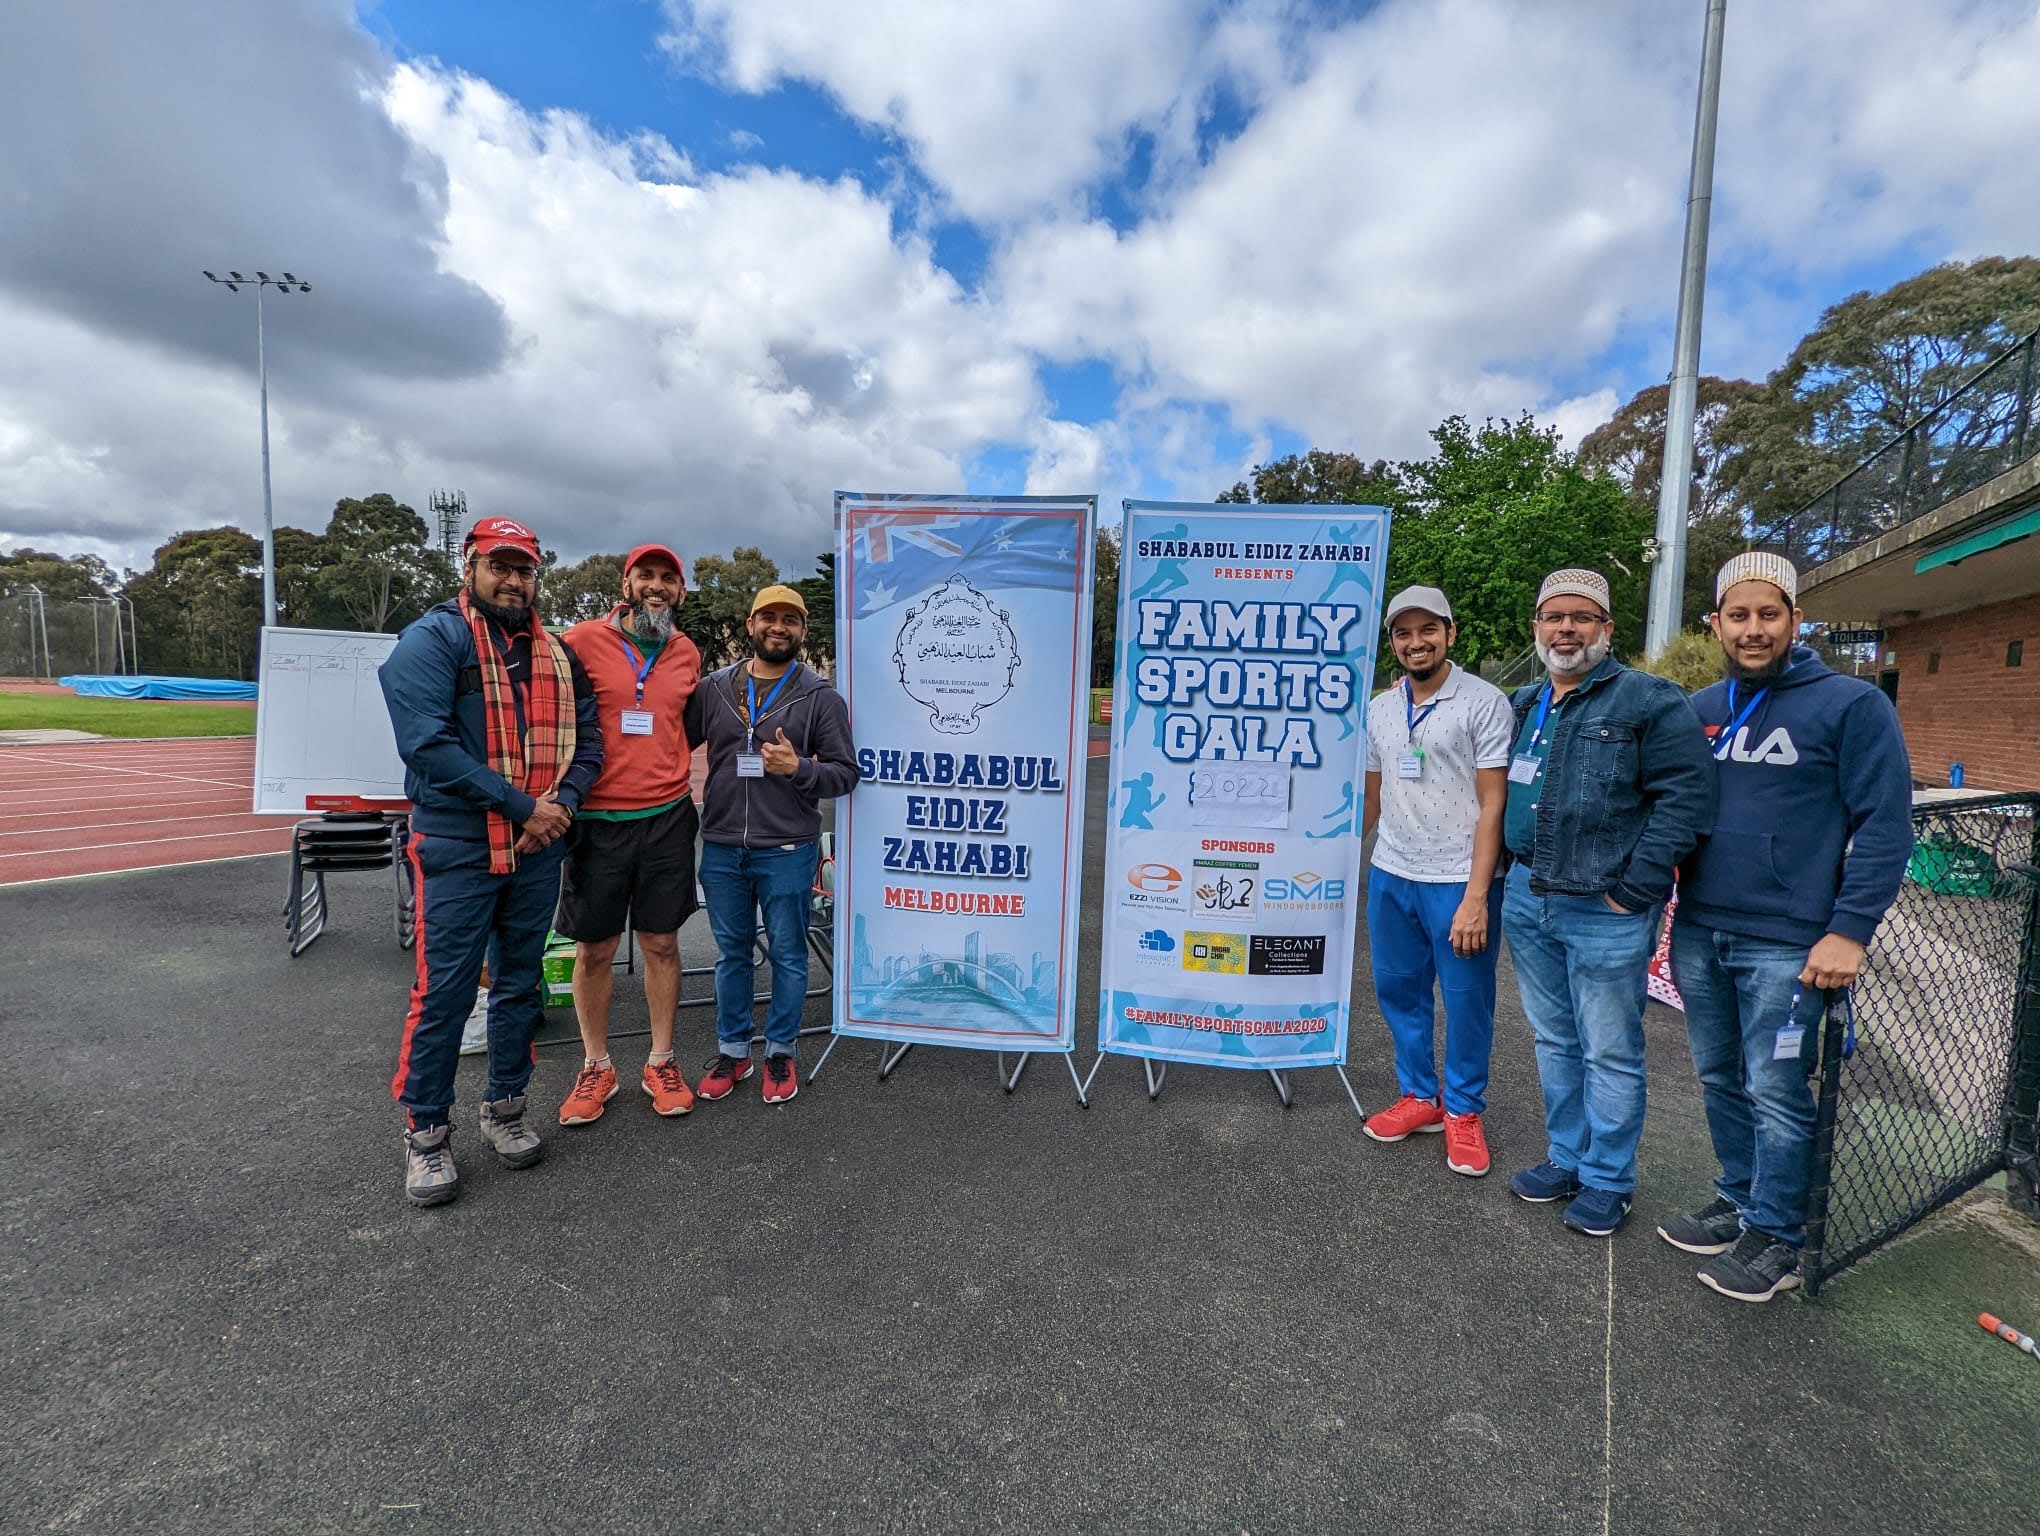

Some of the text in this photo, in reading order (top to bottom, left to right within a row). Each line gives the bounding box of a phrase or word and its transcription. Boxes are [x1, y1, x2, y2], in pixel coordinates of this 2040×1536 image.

[1138, 541, 1371, 562] SHABABUL EIDIZ ZAHABI
[1214, 567, 1294, 580] PRESENTS
[1137, 599, 1358, 654] FAMILY
[1834, 631, 1877, 643] TOILETS
[935, 687, 976, 695] MELBOURNE
[1136, 656, 1352, 711] SPORTS
[1163, 714, 1320, 767] GALA
[857, 748, 1061, 789] SHABABUL
[1198, 773, 1277, 798] 2022
[906, 796, 1006, 833] EIDIZ
[883, 837, 1029, 877] ZAHABI
[1201, 839, 1275, 853] SPONSORS
[884, 886, 1024, 916] MELBOURNE
[1129, 893, 1179, 904] EZZI VISION
[1264, 879, 1345, 900] SMB
[1254, 938, 1323, 951] ELEGANT
[1125, 1007, 1328, 1036] #FAMILYSPORTSGALA2020
